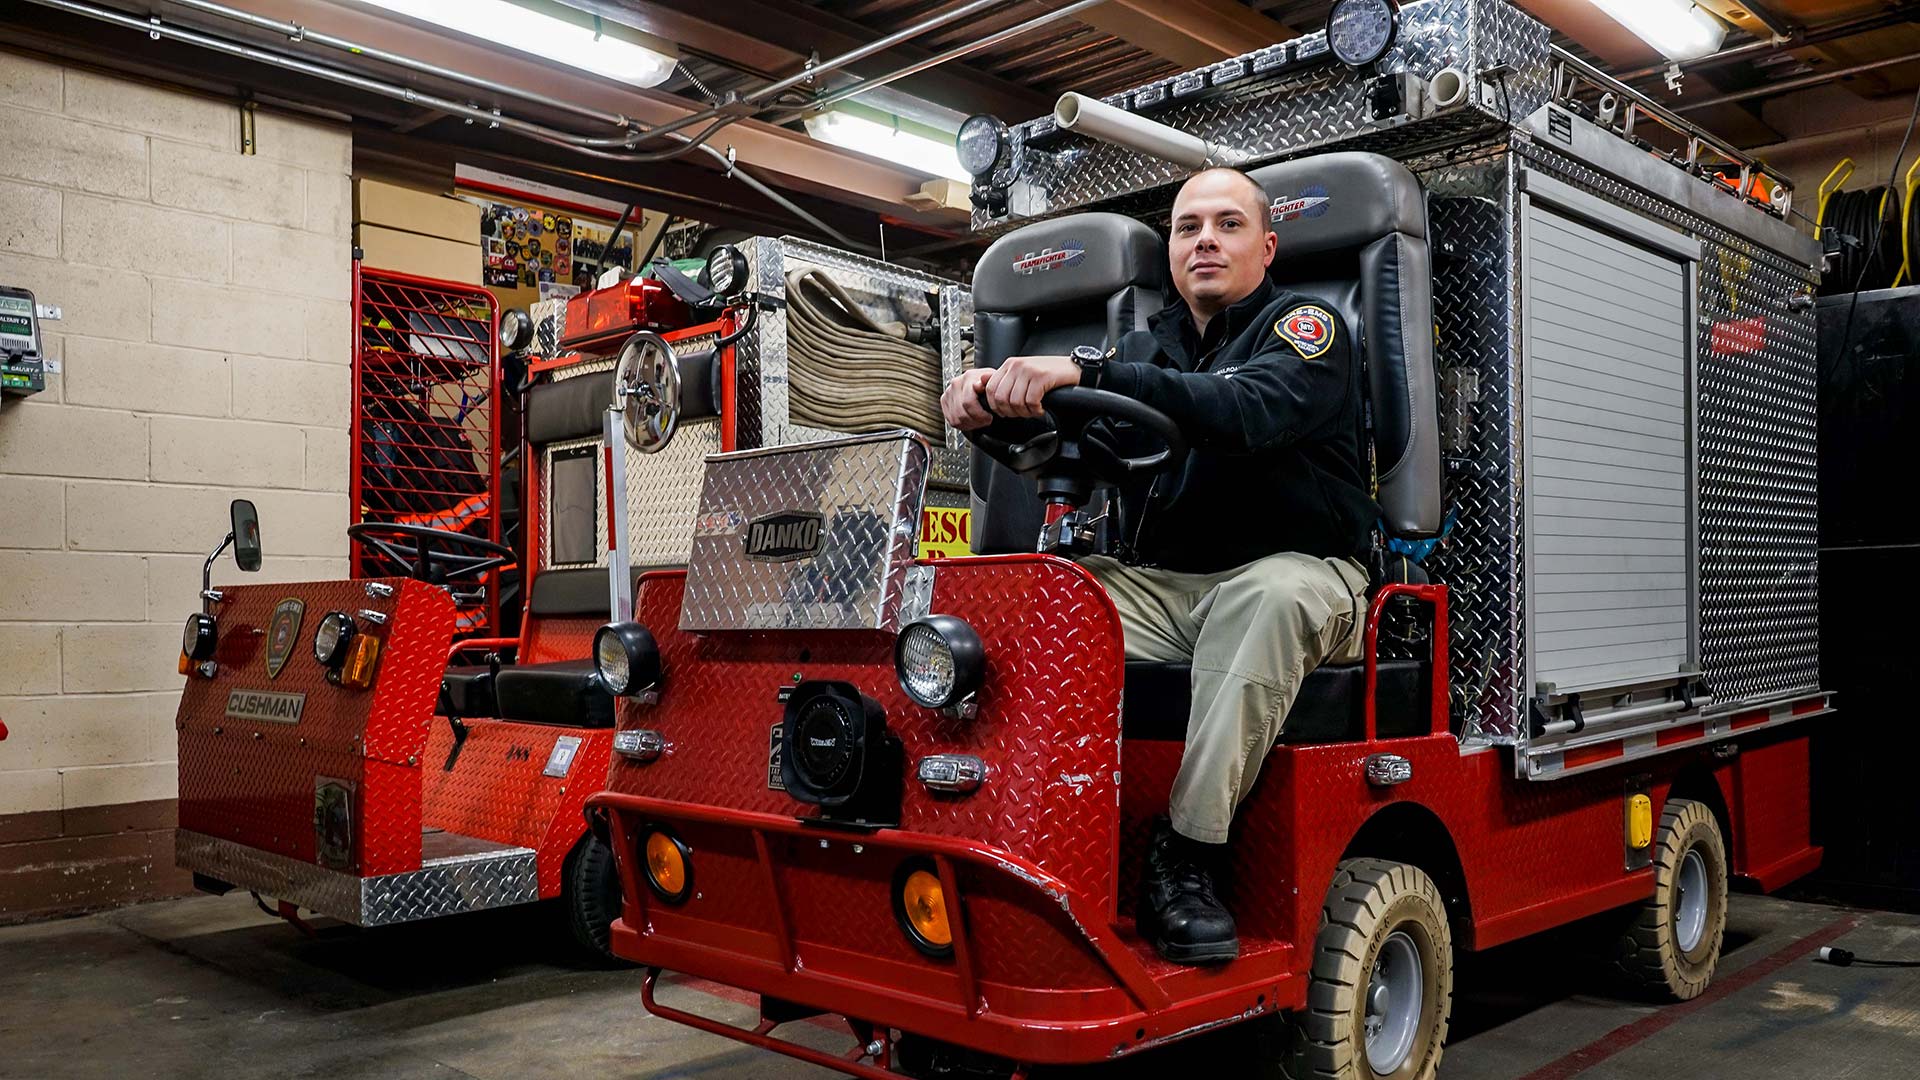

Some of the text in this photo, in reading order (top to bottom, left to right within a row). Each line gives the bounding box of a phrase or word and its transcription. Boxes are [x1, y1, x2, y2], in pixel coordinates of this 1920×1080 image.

[1271, 201, 1305, 216] FIGHTER
[749, 518, 819, 554] DANKO
[228, 694, 300, 718] CUSHMAN
